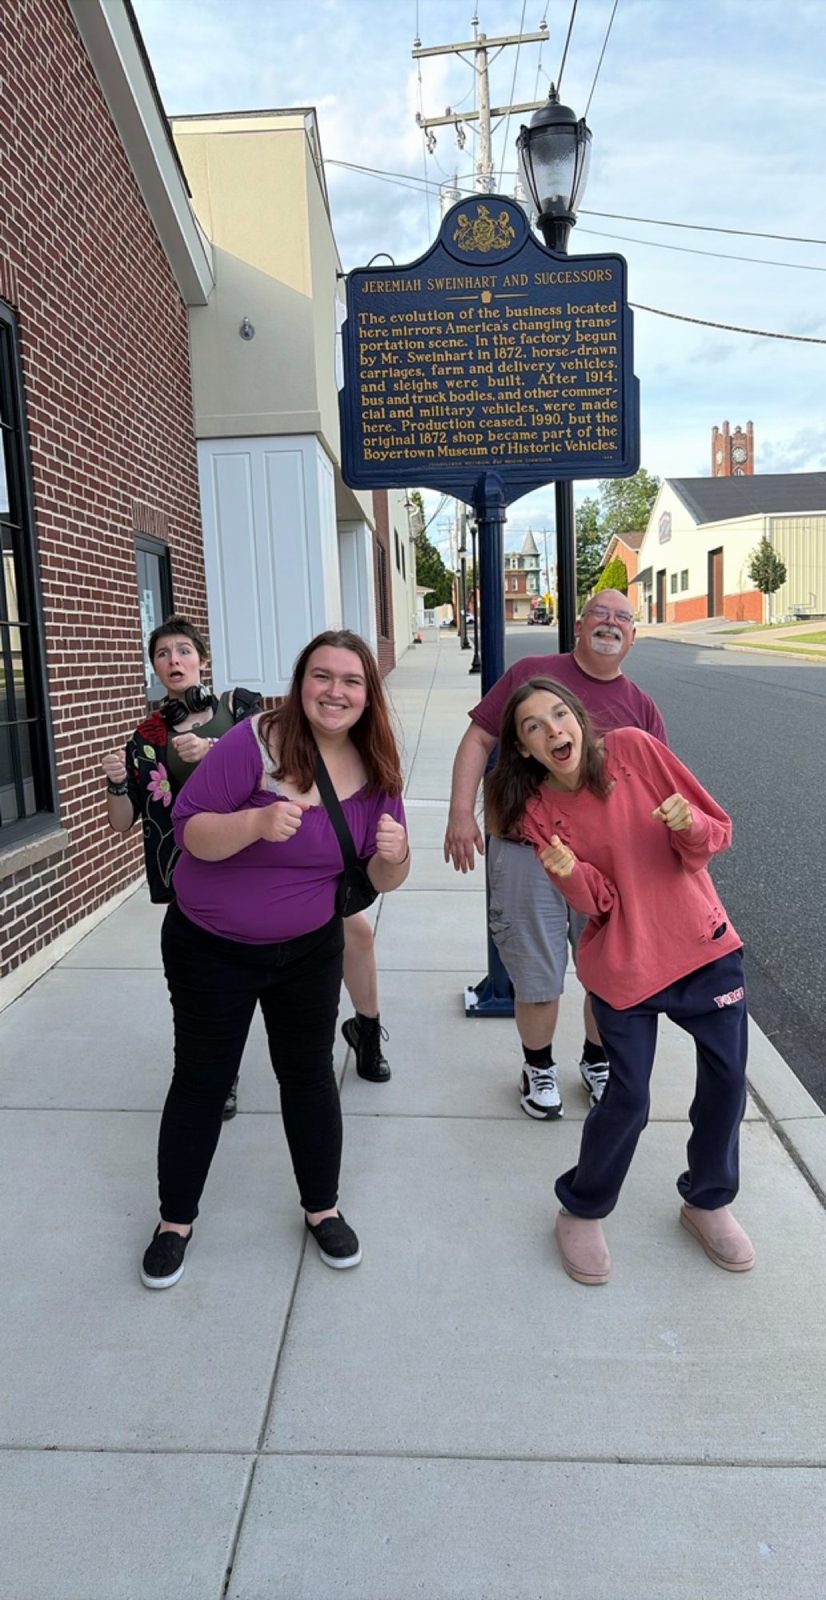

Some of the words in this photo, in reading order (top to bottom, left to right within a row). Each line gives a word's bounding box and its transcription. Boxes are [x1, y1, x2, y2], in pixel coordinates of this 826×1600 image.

[362, 279, 421, 293] JEREMIAH
[428, 275, 496, 290] SWEINHART
[504, 274, 528, 286] AND
[535, 270, 611, 285] SUCCESSORS
[359, 313, 386, 324] The
[391, 310, 455, 323] evolution
[460, 309, 474, 320] of
[478, 308, 500, 319] the
[505, 306, 562, 318] business
[567, 302, 617, 315] located
[359, 327, 389, 338] here
[390, 325, 444, 336] mirrors
[447, 321, 509, 334] America's
[512, 318, 572, 332] changing
[575, 317, 617, 328] trans-
[360, 339, 425, 354] portation
[428, 339, 468, 349] scene.
[475, 336, 489, 347] In
[493, 335, 515, 346] the
[520, 333, 570, 345] factory
[575, 331, 617, 344] begun
[360, 354, 376, 367] by
[381, 353, 403, 364] Mr.
[408, 350, 475, 363] Sweinhart
[477, 350, 490, 360] in
[531, 346, 617, 358] horse-drawn
[431, 365, 465, 376] farm
[469, 363, 494, 375] and
[497, 362, 554, 374] delivery
[360, 380, 387, 391] and
[393, 378, 439, 392] sleighs
[446, 379, 478, 388] were
[487, 375, 525, 387] built.
[539, 374, 577, 385] After
[360, 394, 385, 405] bus
[386, 393, 410, 404] and
[412, 391, 446, 403] truck
[497, 389, 523, 400] and
[523, 388, 559, 399] other
[561, 388, 618, 398] commer-
[361, 407, 386, 419] cial
[389, 406, 415, 418] and
[419, 405, 474, 418] military
[544, 403, 576, 412] were
[581, 400, 617, 411] made
[362, 421, 397, 432] here.
[402, 418, 476, 431] Production
[568, 413, 593, 425] but
[596, 413, 618, 424] the
[362, 433, 416, 448] original
[419, 432, 447, 444] 1872
[452, 431, 484, 444] shop
[488, 430, 538, 441] became
[542, 428, 572, 442] part
[577, 427, 593, 438] of
[596, 426, 617, 437] the
[363, 447, 434, 461] Boyertown
[437, 446, 489, 456] Museum
[491, 443, 507, 455] of
[508, 442, 561, 454] Historic
[564, 440, 618, 452] Vehicles.
